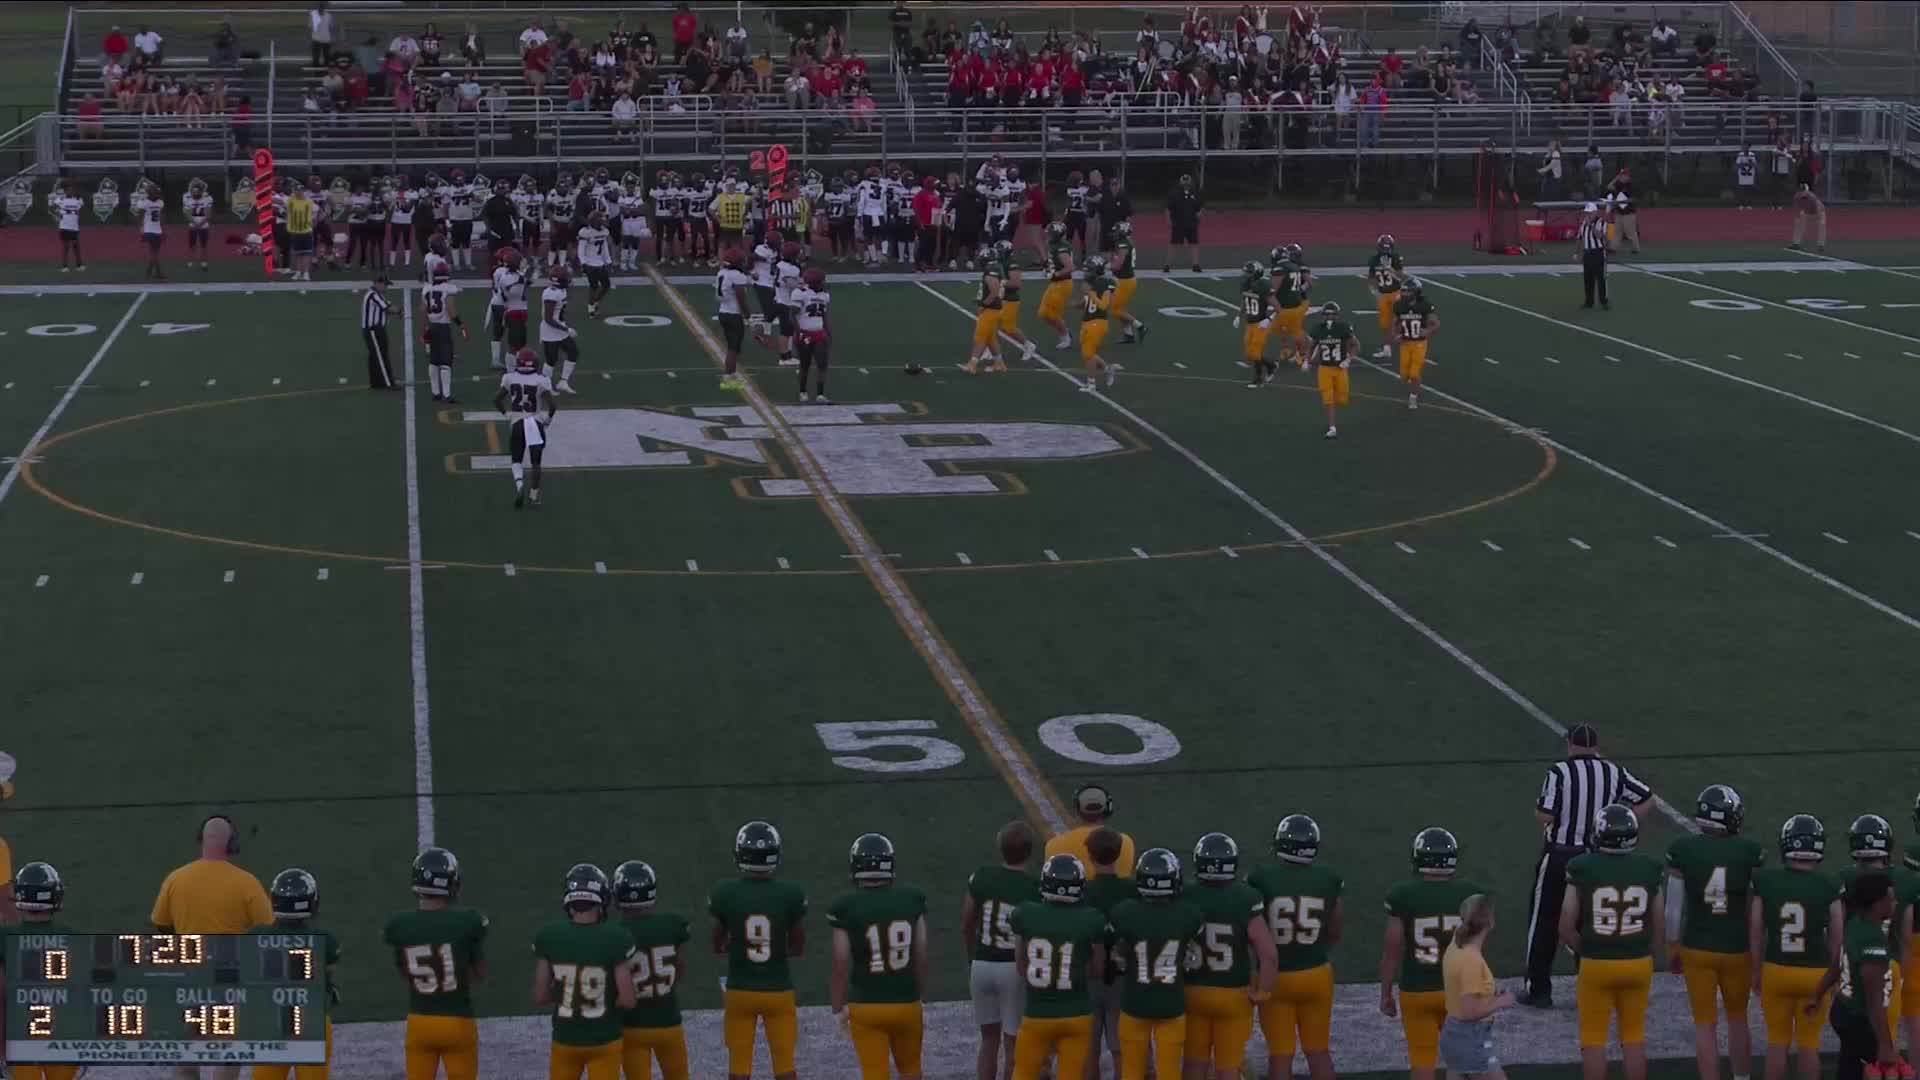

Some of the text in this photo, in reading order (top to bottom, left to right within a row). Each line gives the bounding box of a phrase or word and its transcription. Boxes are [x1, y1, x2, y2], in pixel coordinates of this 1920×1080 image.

[591, 238, 606, 256] 7
[425, 289, 444, 314] 13
[1319, 343, 1342, 362] 24
[1401, 319, 1422, 339] 10
[510, 383, 538, 414] 23
[1591, 885, 1649, 936] 62
[1703, 866, 1727, 916] 4
[744, 913, 772, 964] 9
[1268, 895, 1326, 945] 65
[1779, 901, 1807, 953] 2
[405, 942, 459, 995] 51
[631, 944, 678, 999] 25
[864, 919, 912, 974] 18
[1026, 938, 1075, 990] 81
[1135, 939, 1180, 984] 14
[552, 963, 608, 1019] 79
